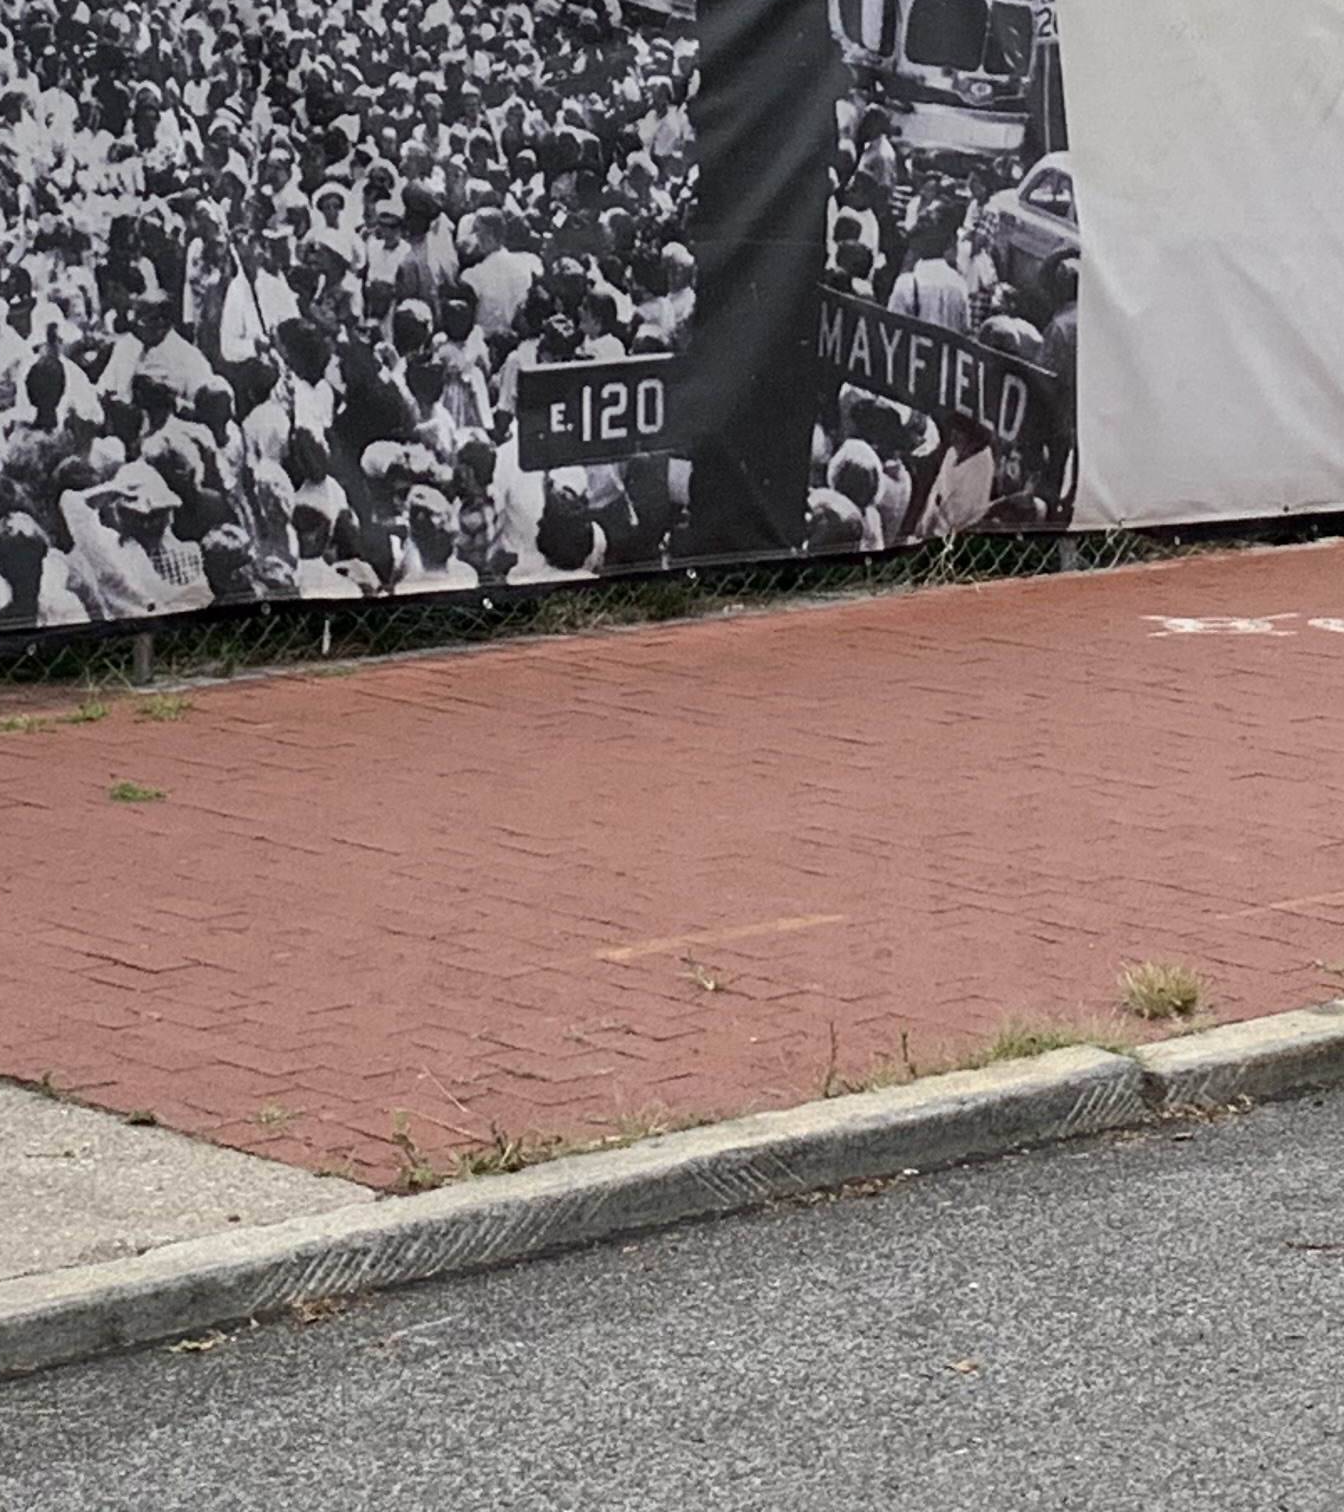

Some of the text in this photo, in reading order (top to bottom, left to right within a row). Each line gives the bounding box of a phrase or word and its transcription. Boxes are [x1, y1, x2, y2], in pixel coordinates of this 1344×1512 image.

[549, 378, 665, 442] E. 120
[817, 300, 1027, 442] MAYFIELD
